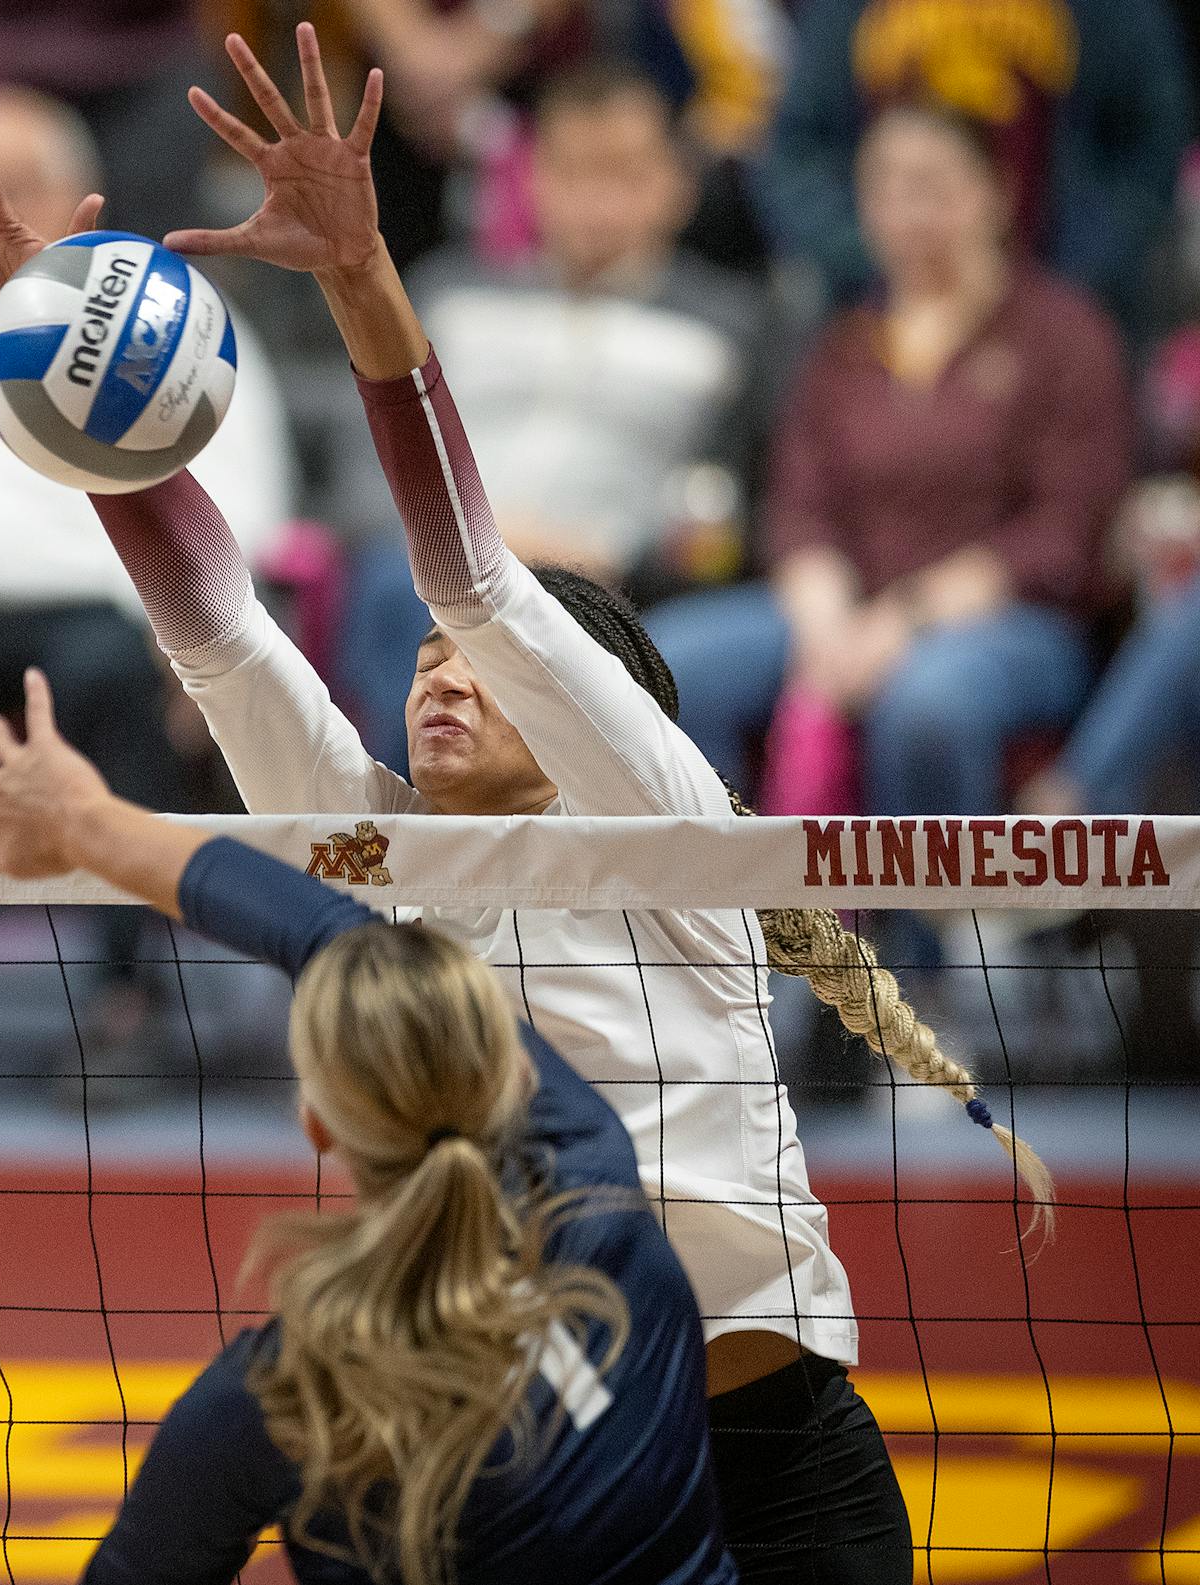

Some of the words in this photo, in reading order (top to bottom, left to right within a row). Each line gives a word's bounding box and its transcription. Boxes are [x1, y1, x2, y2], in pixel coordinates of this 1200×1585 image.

[66, 257, 138, 387] molten
[114, 273, 187, 396] NCAA
[802, 820, 1171, 888] MINNESOTA
